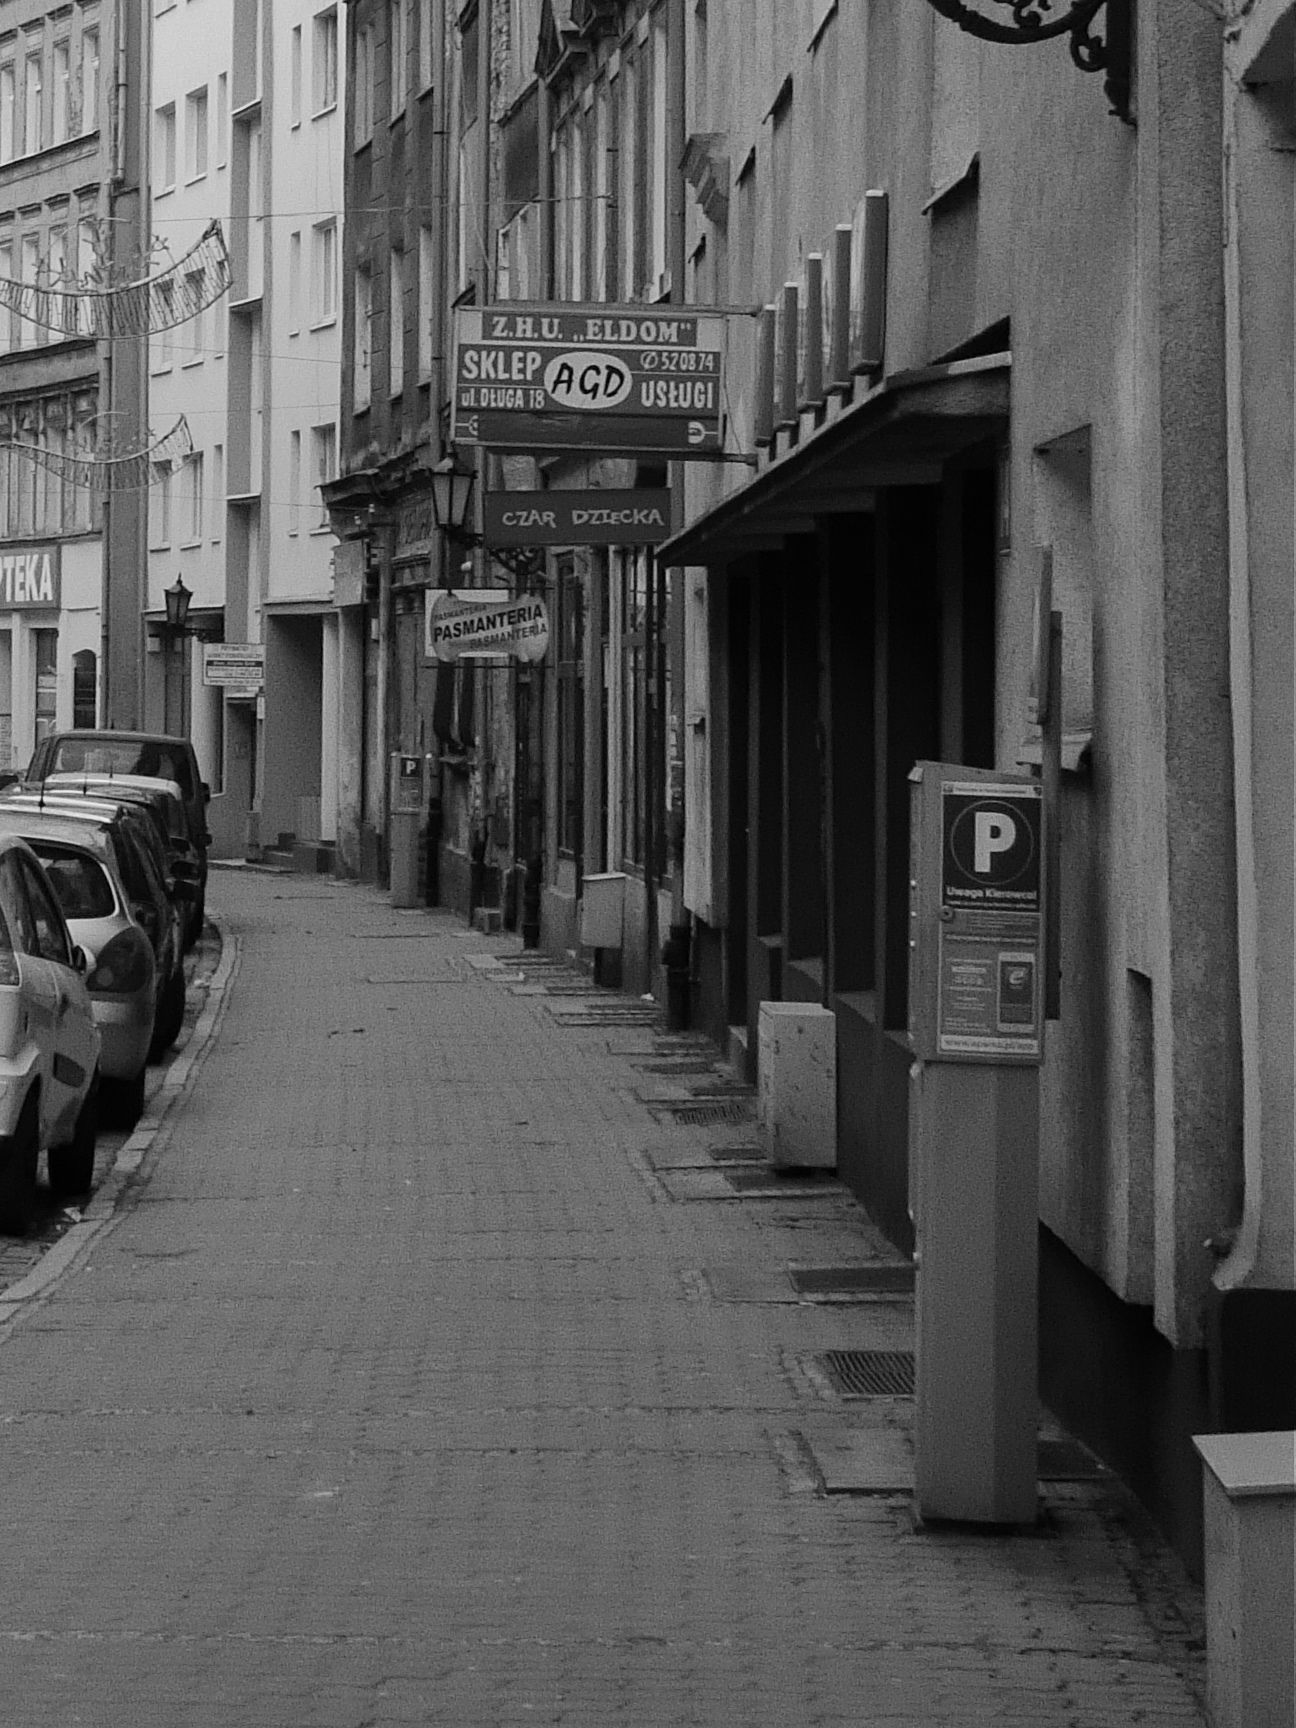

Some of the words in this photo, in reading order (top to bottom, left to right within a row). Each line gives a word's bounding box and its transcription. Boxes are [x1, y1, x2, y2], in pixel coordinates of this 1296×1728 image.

[492, 316, 563, 339] Z.H.U.
[462, 349, 542, 381] SKLEP
[551, 362, 625, 400] AGD
[480, 388, 525, 408] DŁUGA
[530, 389, 545, 409] 18
[640, 381, 714, 409] USŁUGI
[501, 508, 557, 528] CZAR
[571, 508, 665, 526] DZIECKA
[433, 604, 543, 643] PASMANTERIA
[470, 623, 547, 648] PASMANTERIA
[406, 760, 417, 774] P
[974, 811, 1016, 873] P
